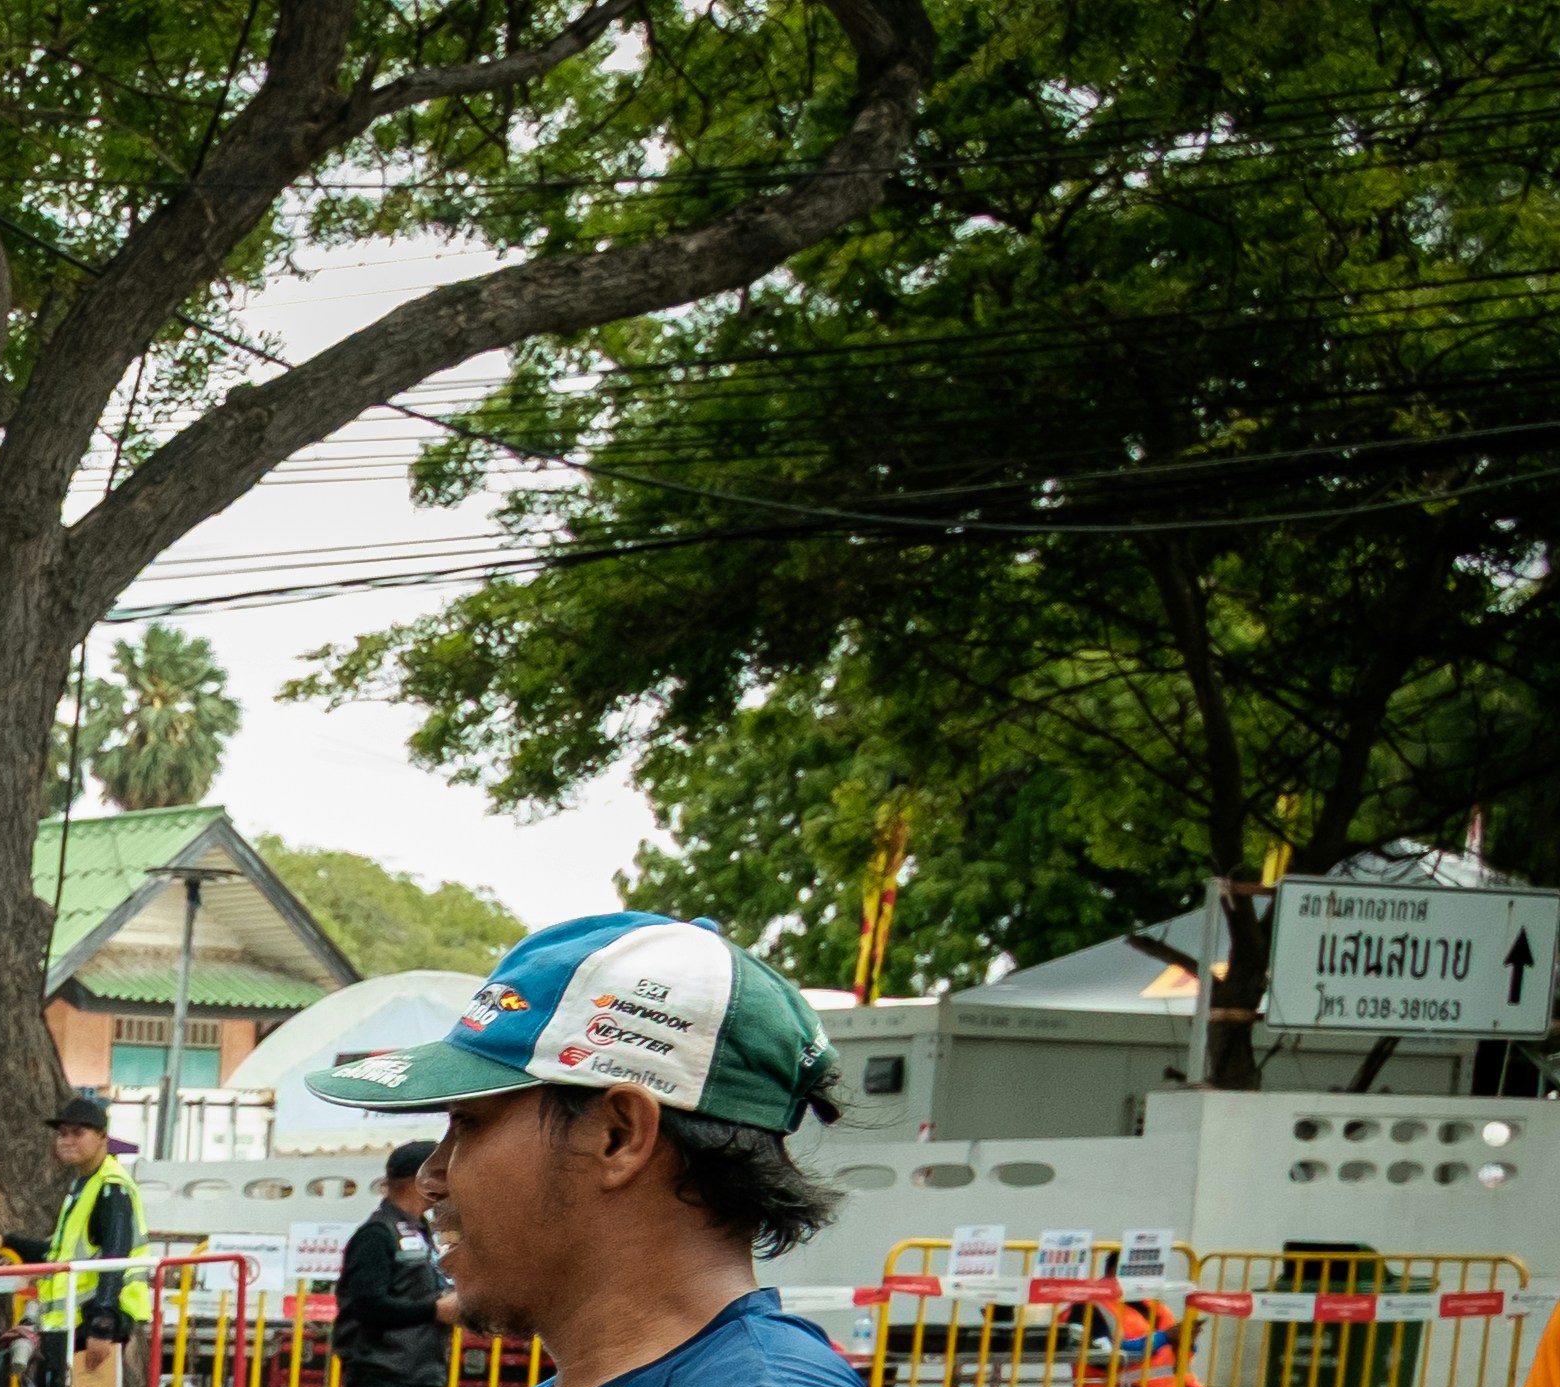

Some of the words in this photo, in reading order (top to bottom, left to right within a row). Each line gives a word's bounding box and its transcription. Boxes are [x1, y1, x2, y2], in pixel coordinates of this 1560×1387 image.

[1316, 929, 1473, 982] แสนสบาย
[1355, 995, 1462, 1022] 038-381063
[592, 1022, 674, 1056] NEXZTER
[589, 1055, 678, 1095] idemitsu
